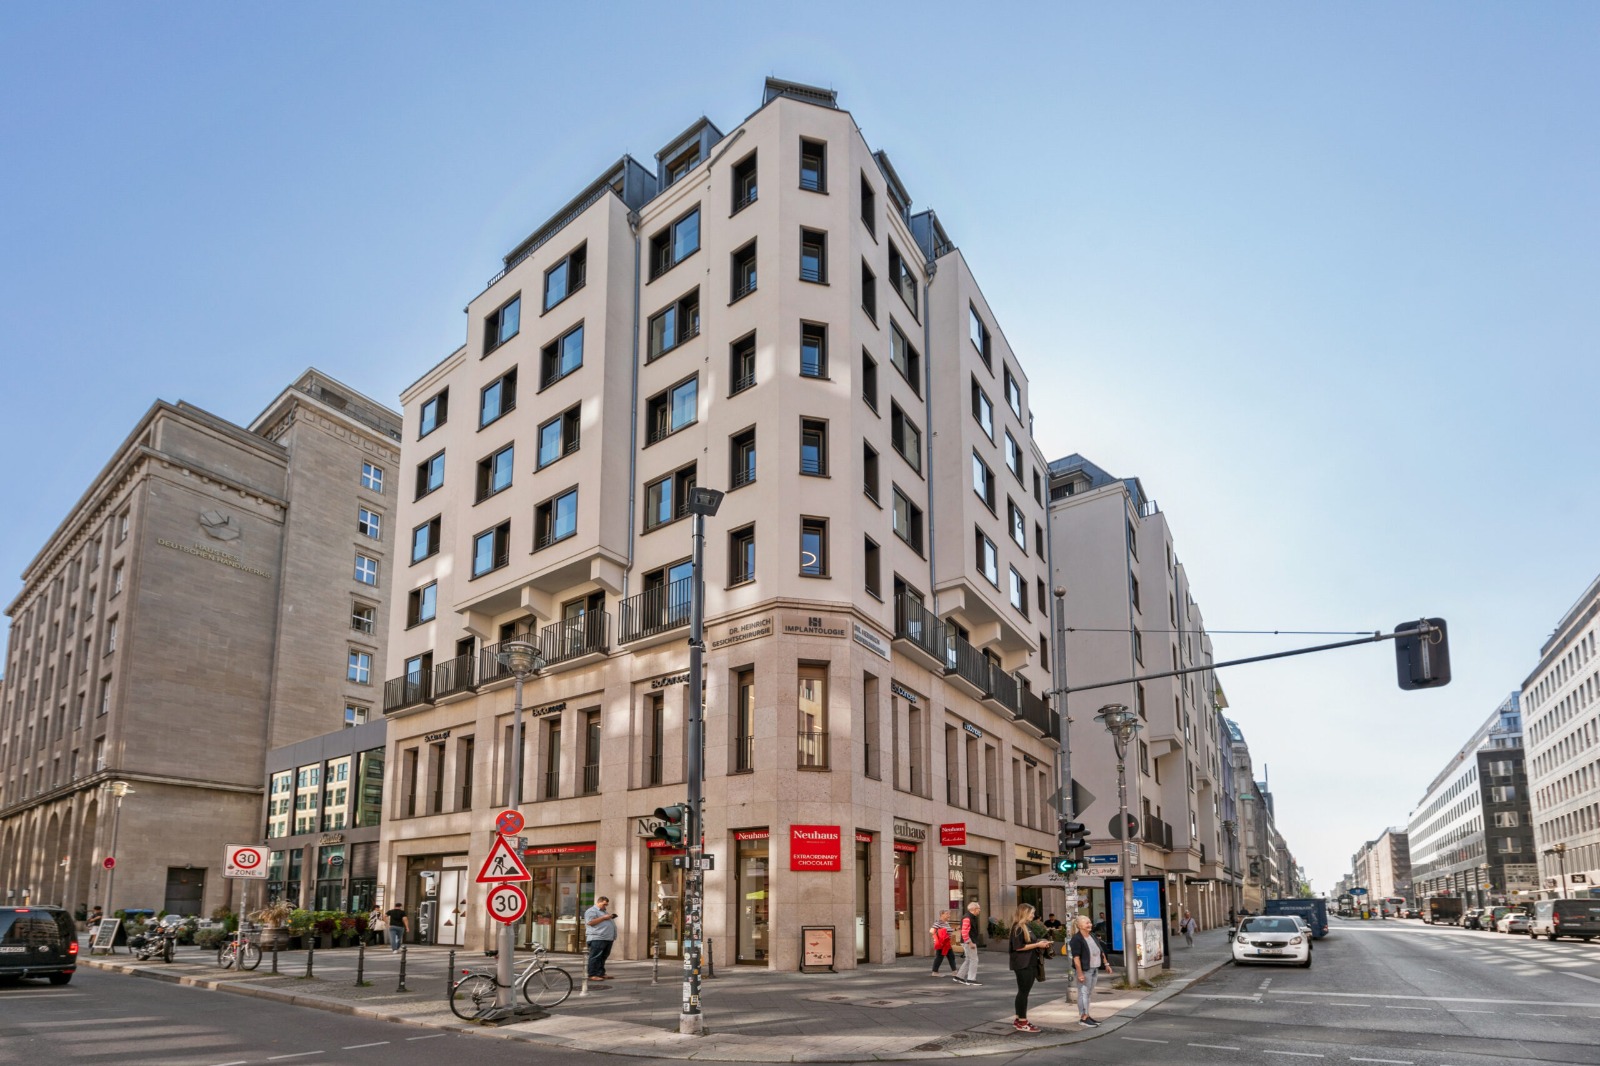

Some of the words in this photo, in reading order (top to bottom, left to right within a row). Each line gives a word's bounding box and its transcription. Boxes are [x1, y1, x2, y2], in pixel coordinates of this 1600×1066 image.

[157, 538, 215, 561] DEUTSCHEN
[194, 543, 220, 556] HAUS
[221, 551, 240, 562] DES
[740, 618, 771, 632] HEINRICH
[785, 625, 845, 636] IMPLANTOLOGIE
[793, 830, 839, 840] Neuhaus
[894, 822, 926, 840] euhaus
[239, 854, 255, 864] 30
[495, 894, 518, 912] 30
